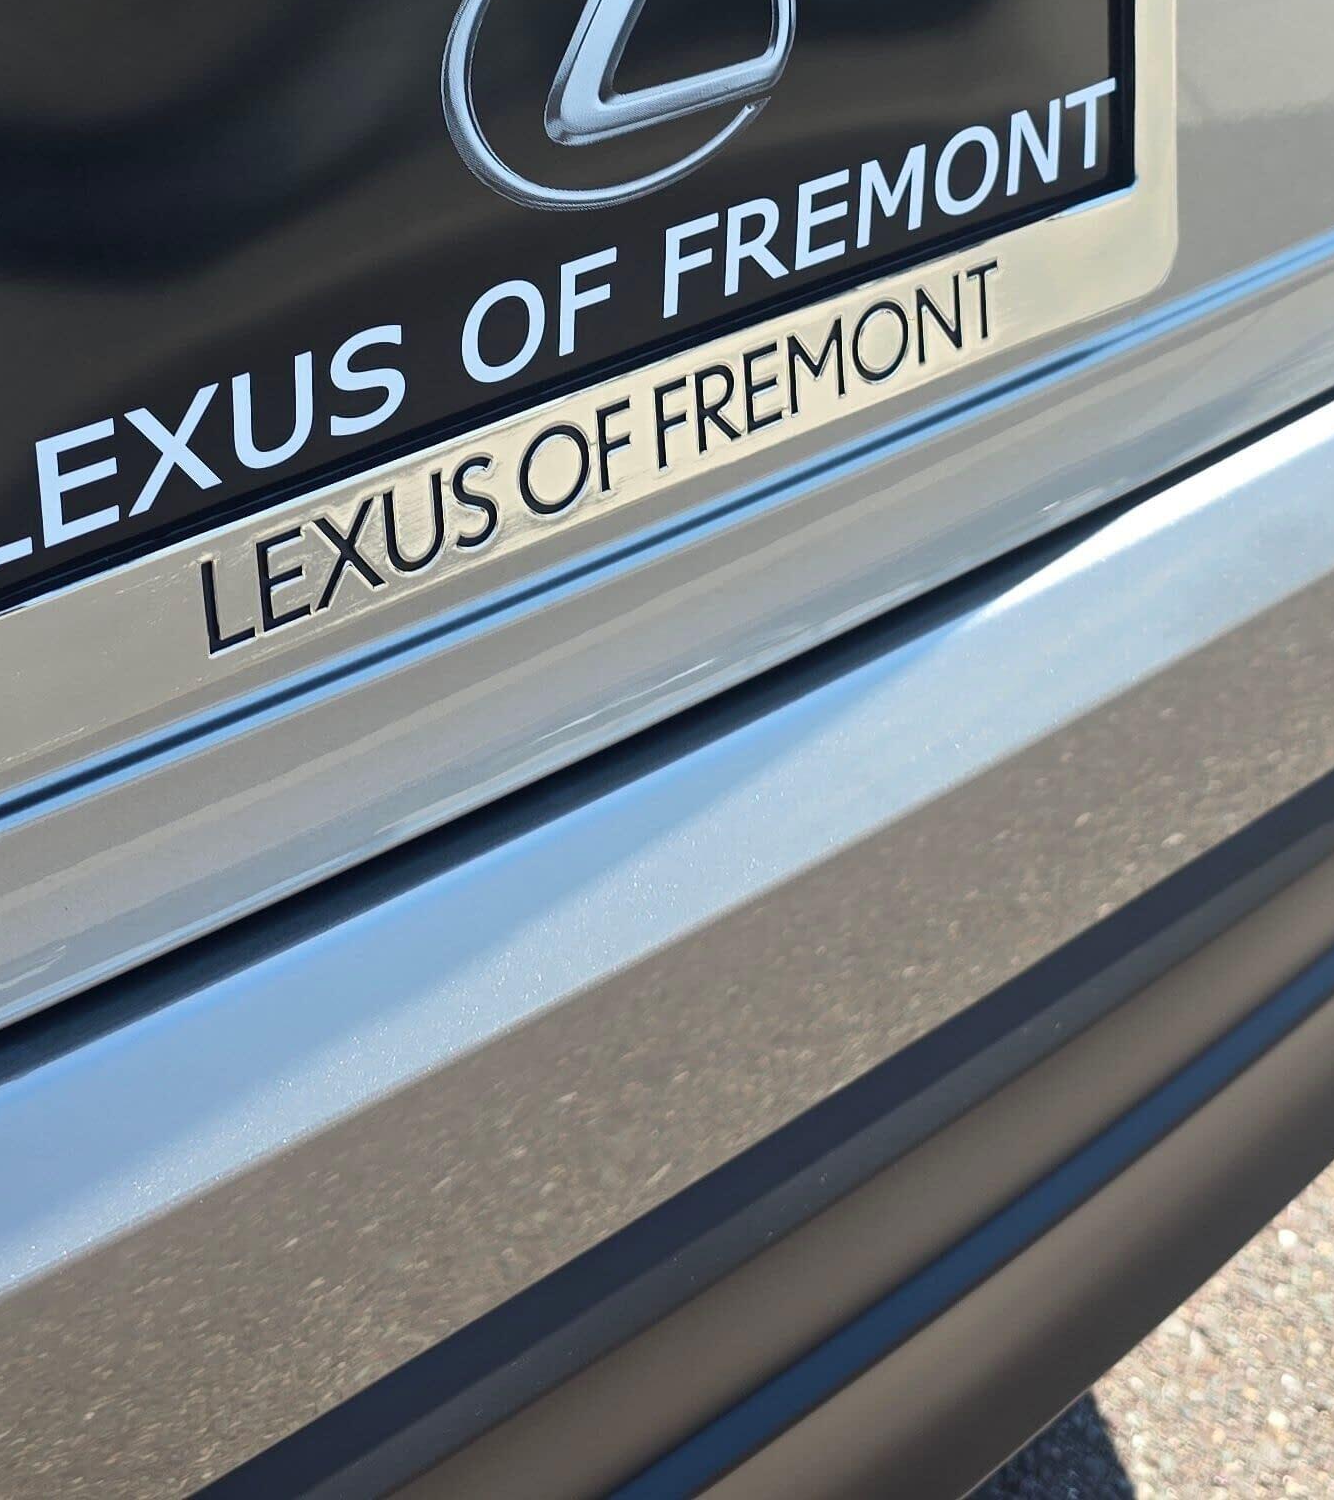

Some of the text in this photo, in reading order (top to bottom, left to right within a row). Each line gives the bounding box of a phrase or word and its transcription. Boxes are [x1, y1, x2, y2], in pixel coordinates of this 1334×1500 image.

[460, 247, 617, 384] OF
[661, 77, 1117, 319] FREMONT
[202, 261, 1000, 655] LEXUS OF FREMONT
